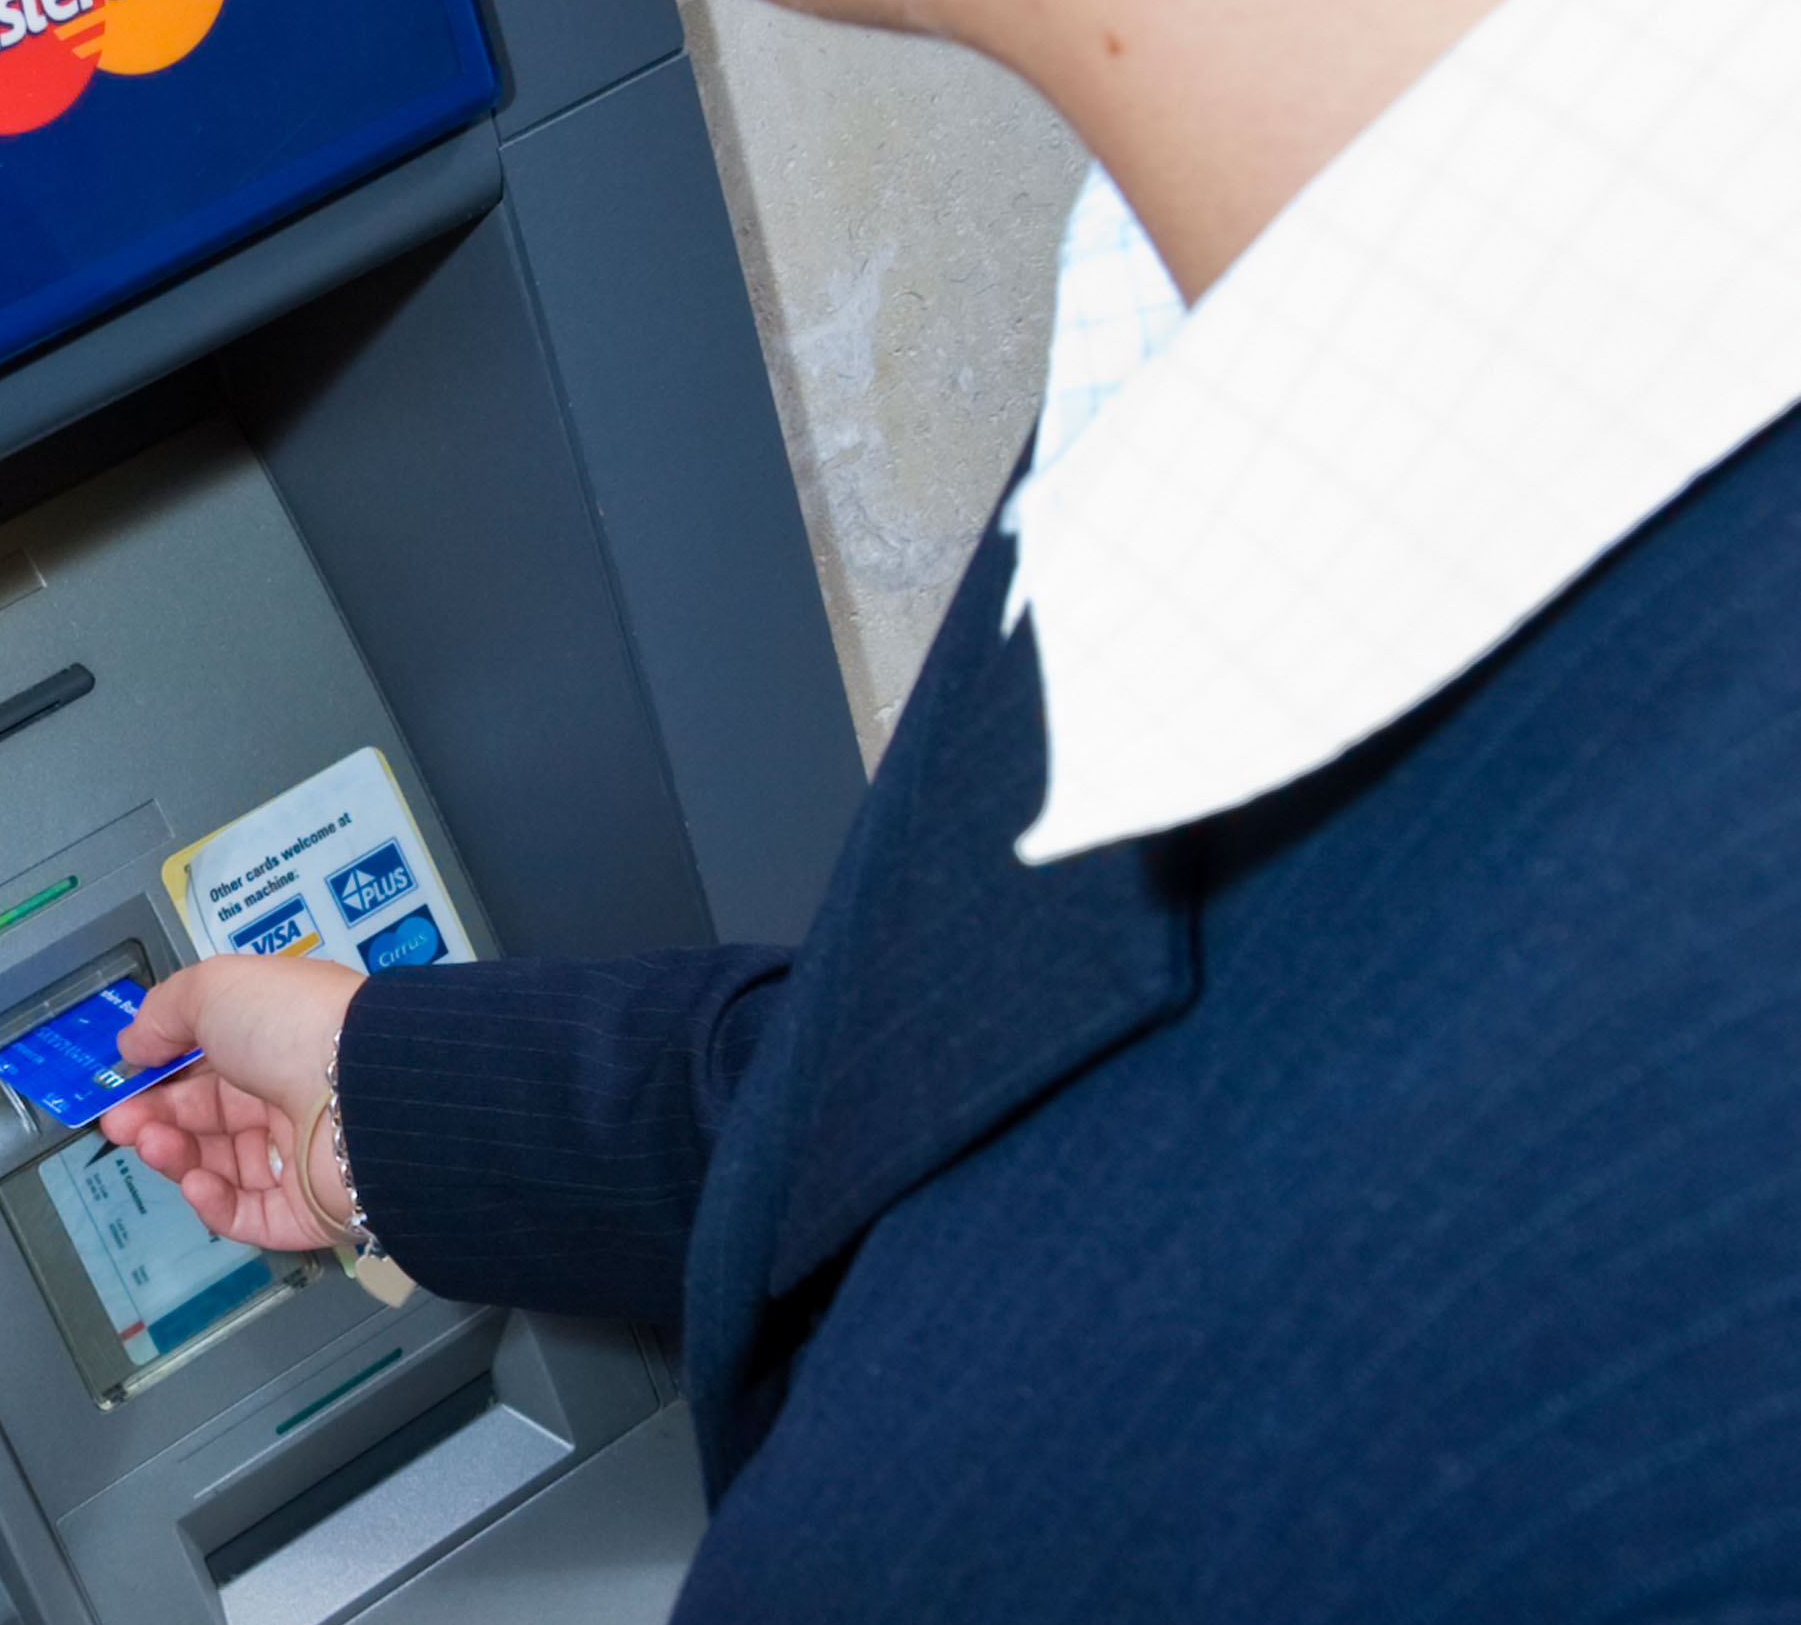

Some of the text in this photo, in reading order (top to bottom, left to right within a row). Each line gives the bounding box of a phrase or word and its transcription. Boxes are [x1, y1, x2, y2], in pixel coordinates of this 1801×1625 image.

[209, 811, 352, 903] Other cards welcome at
[362, 866, 408, 909] PLUS
[217, 902, 242, 922] this
[251, 919, 302, 955] VISA
[379, 934, 427, 967] Cirrus
